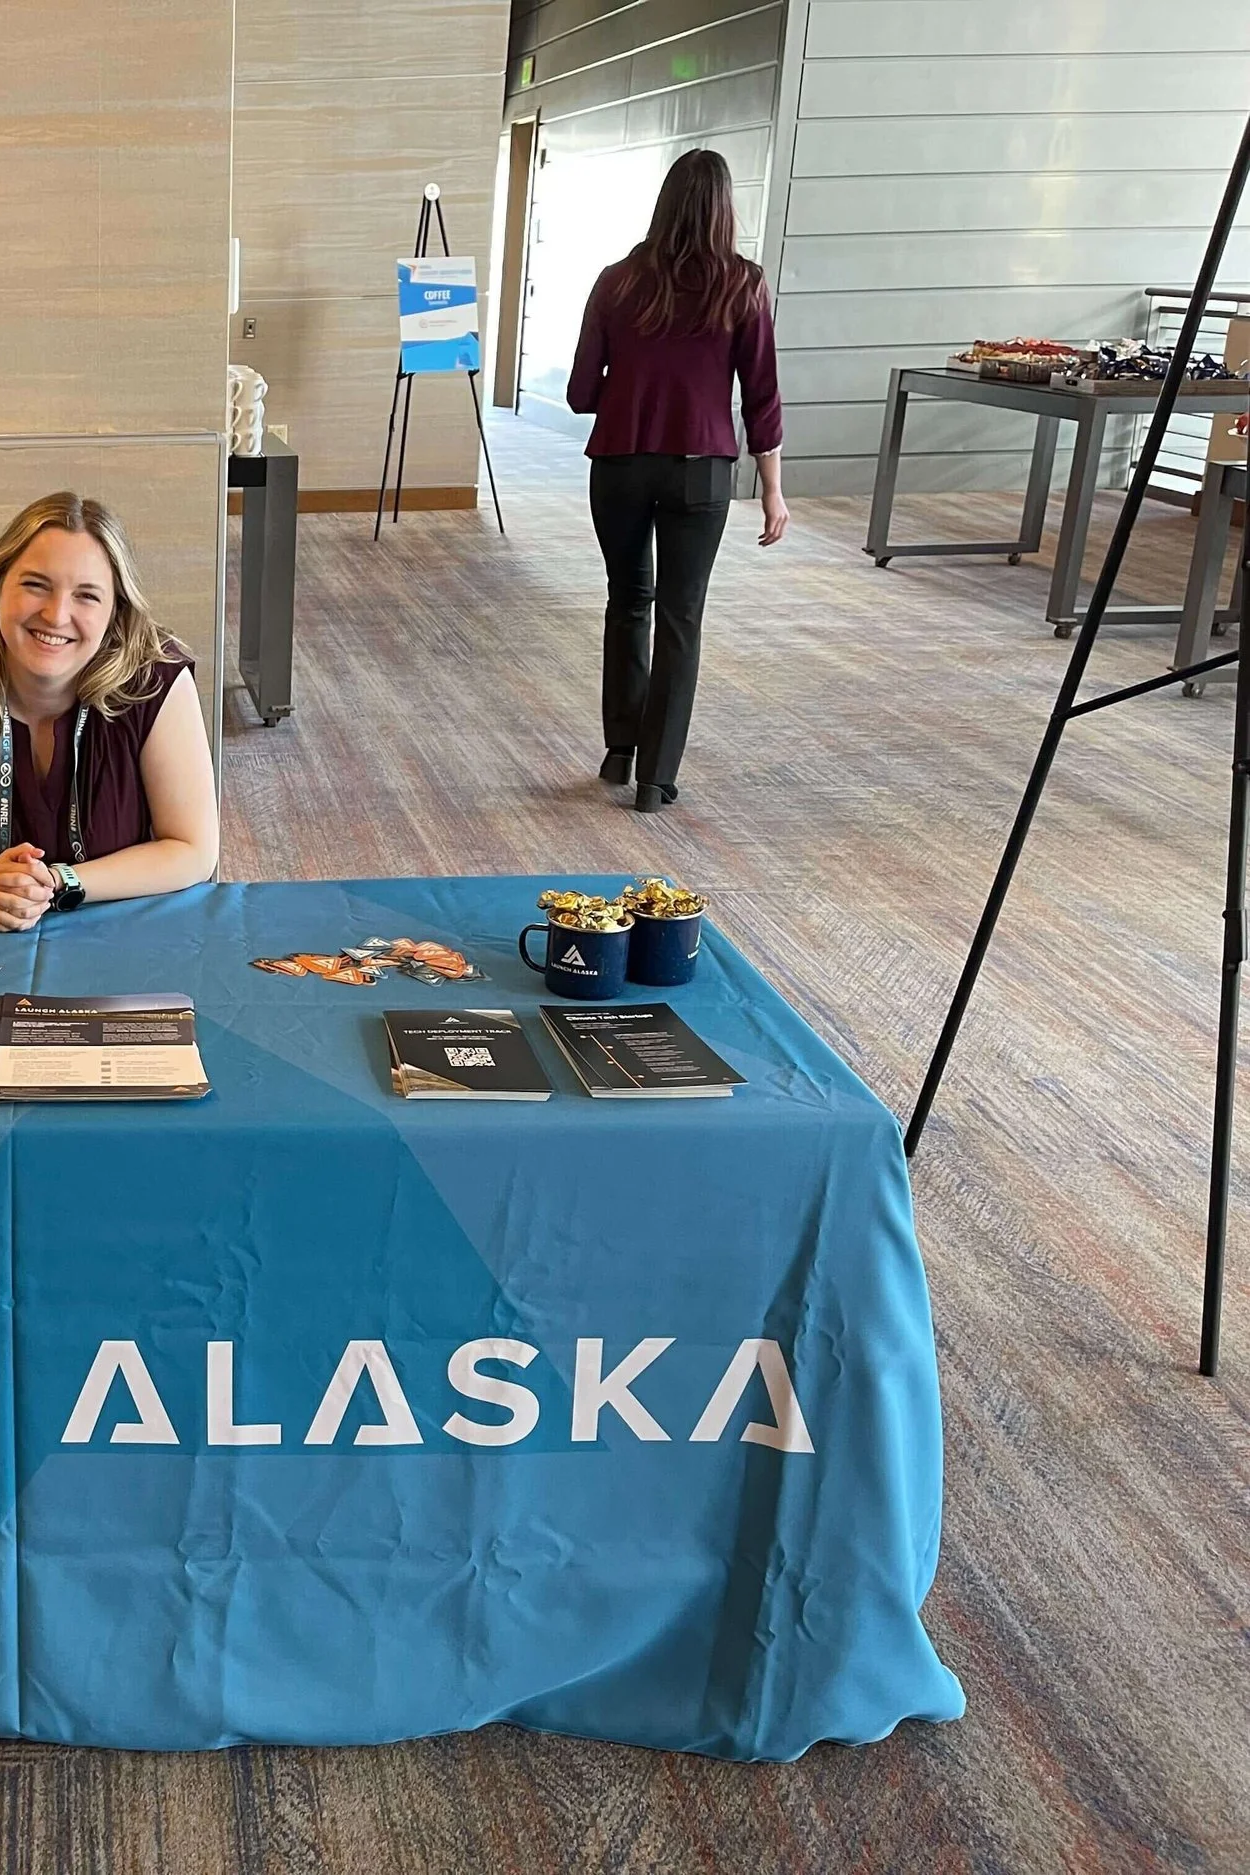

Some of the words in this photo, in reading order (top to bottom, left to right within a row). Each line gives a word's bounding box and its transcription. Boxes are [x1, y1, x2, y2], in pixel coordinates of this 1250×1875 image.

[424, 289, 451, 300] COFFEE
[551, 961, 572, 973] LAUNCH
[572, 967, 599, 976] ALASKA
[60, 1337, 816, 1454] ALASKA
